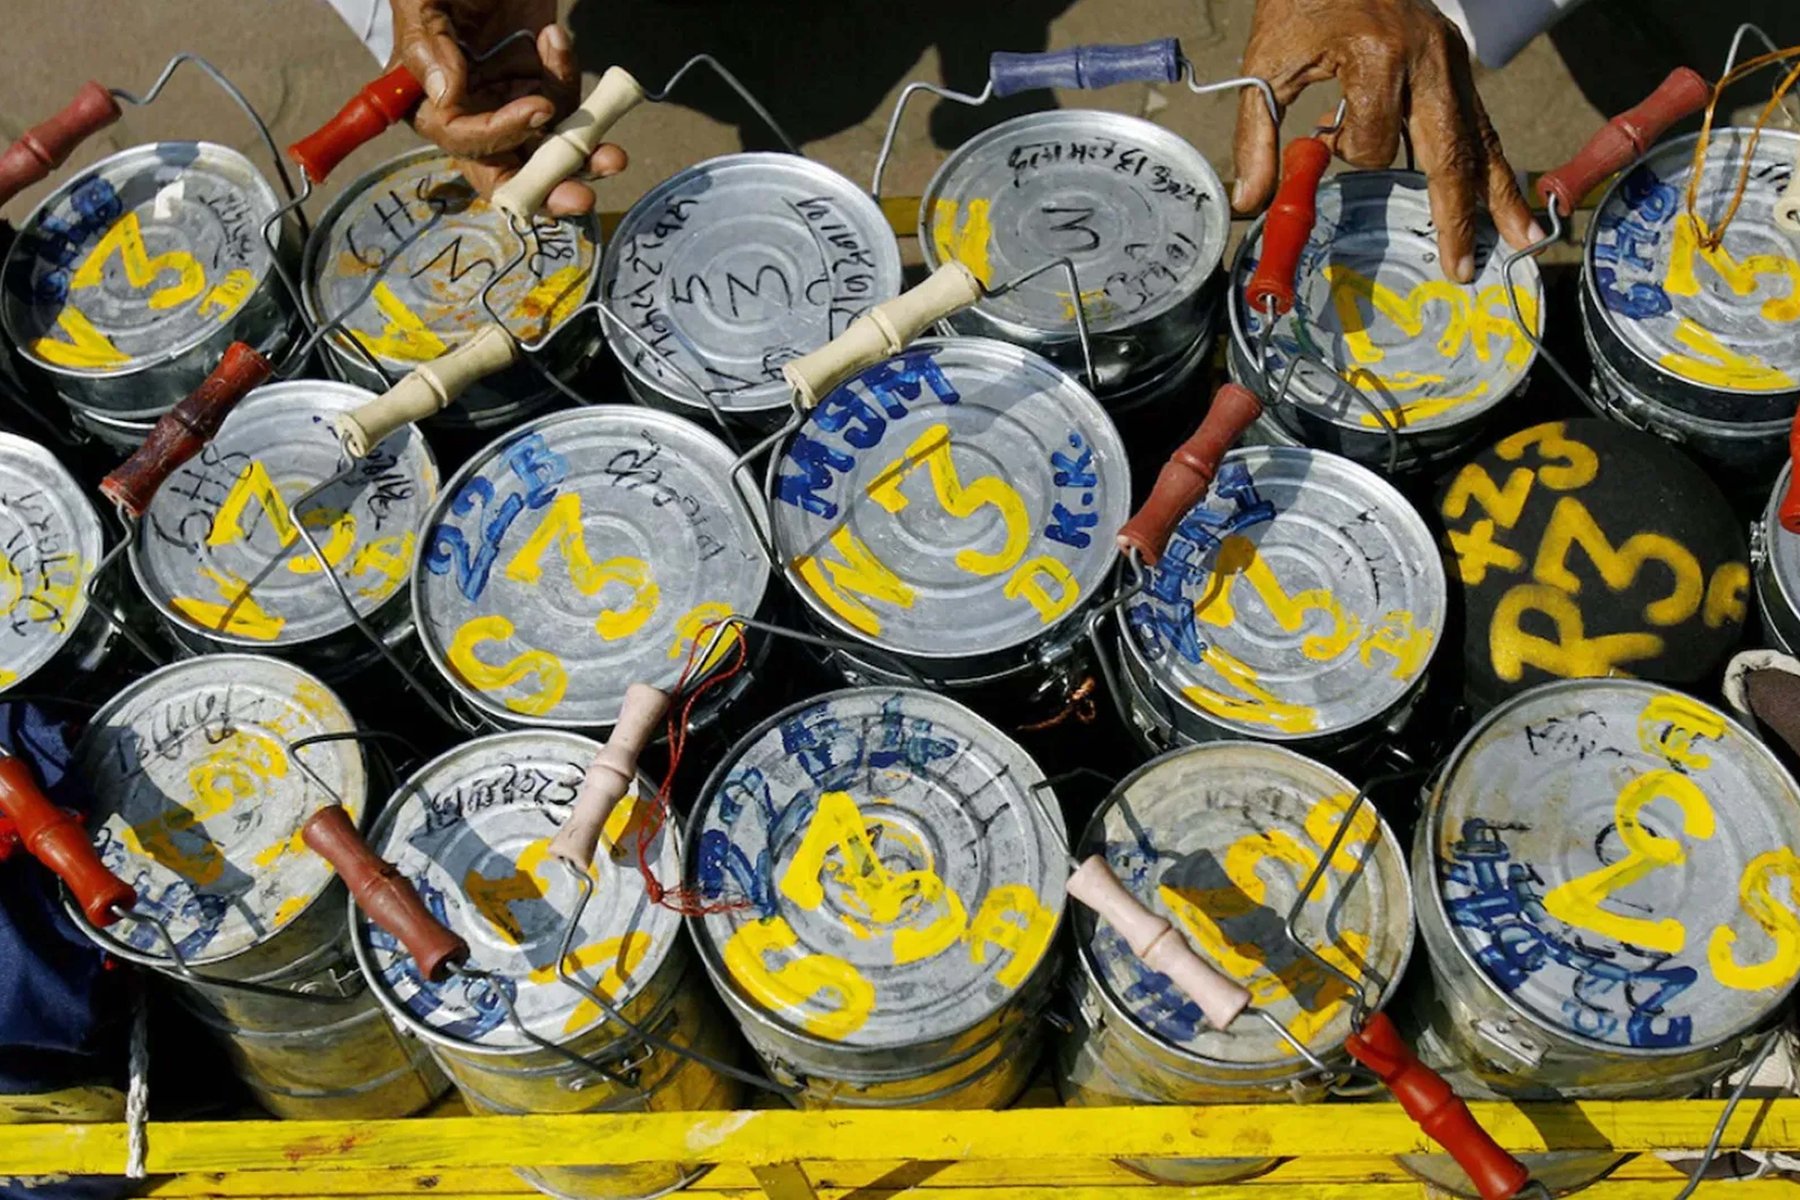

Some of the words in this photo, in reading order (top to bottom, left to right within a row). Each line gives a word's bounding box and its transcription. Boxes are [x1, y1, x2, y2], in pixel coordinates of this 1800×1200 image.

[505, 492, 660, 641] 3
[865, 423, 1031, 577] 3
[1532, 495, 1703, 626] 3
